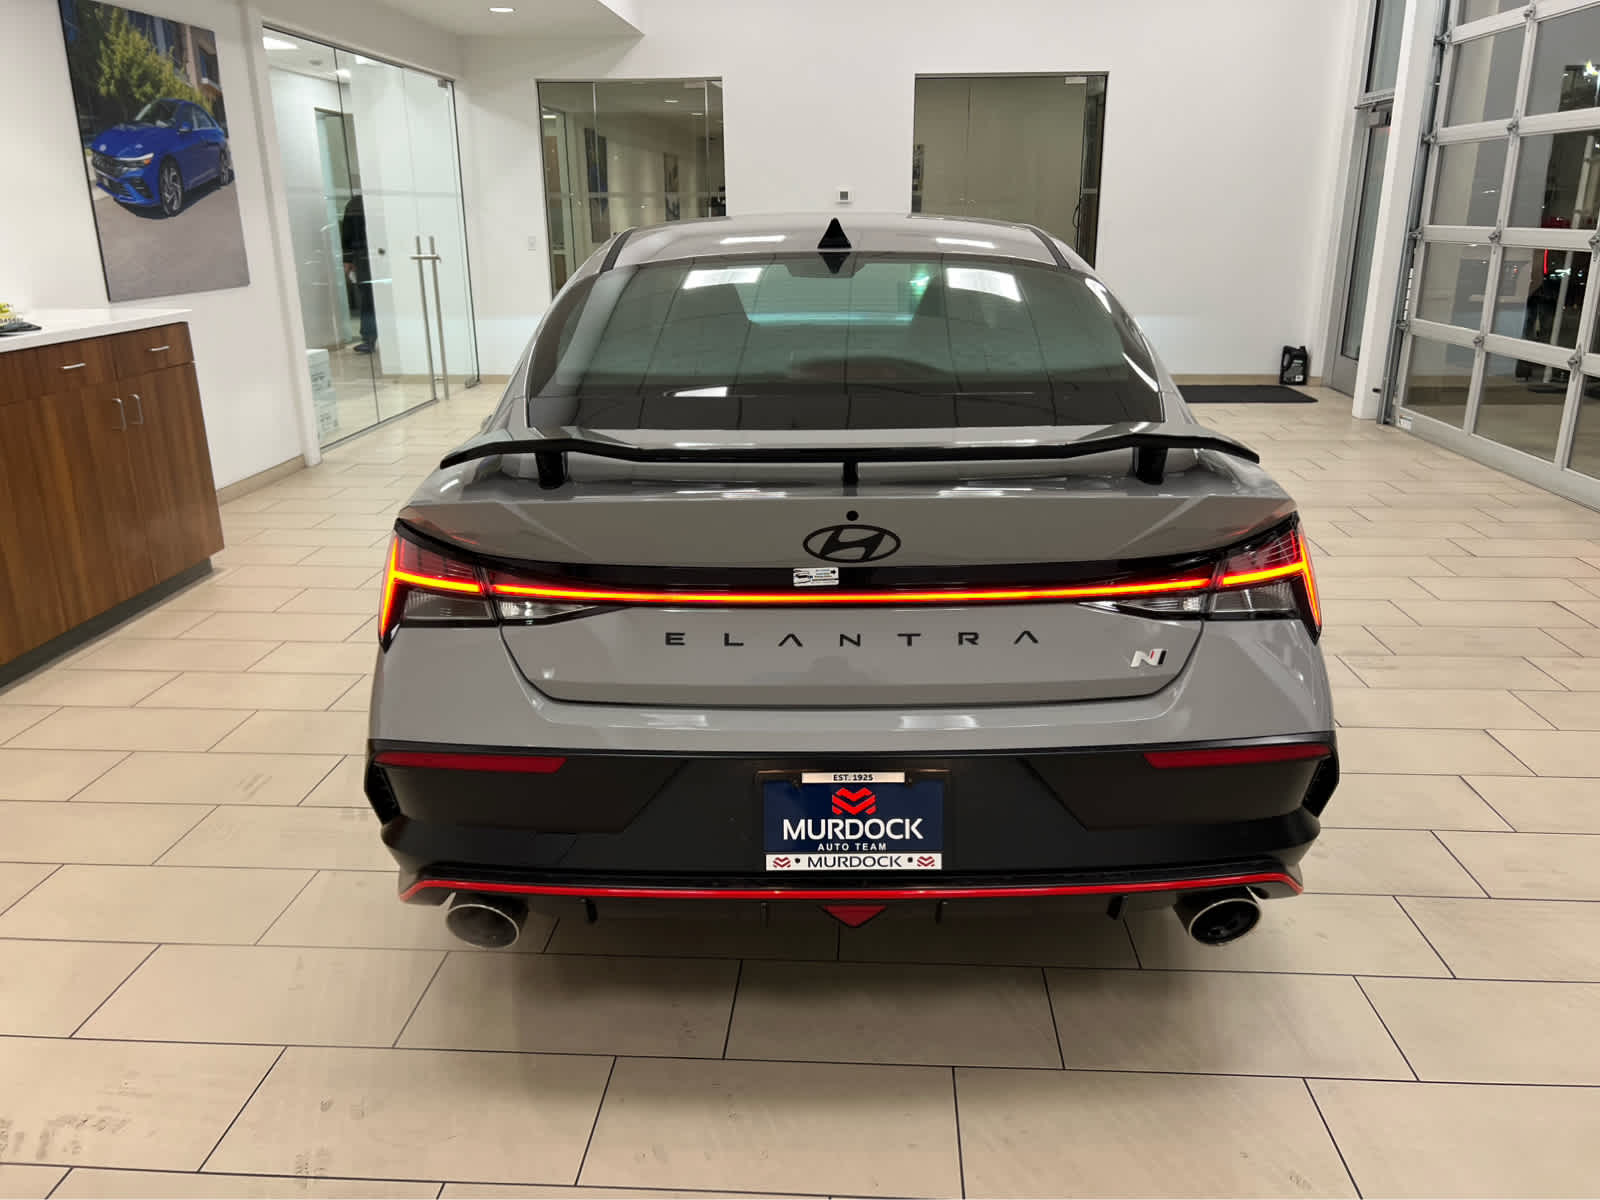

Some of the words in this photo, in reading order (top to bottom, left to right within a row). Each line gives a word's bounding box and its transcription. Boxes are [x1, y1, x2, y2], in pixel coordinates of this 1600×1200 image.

[665, 629, 1039, 647] ELANTRA
[783, 818, 923, 840] MURDOCK
[817, 843, 850, 851] AUTO
[855, 843, 887, 851] TEAM
[807, 855, 902, 868] MURDOCK
